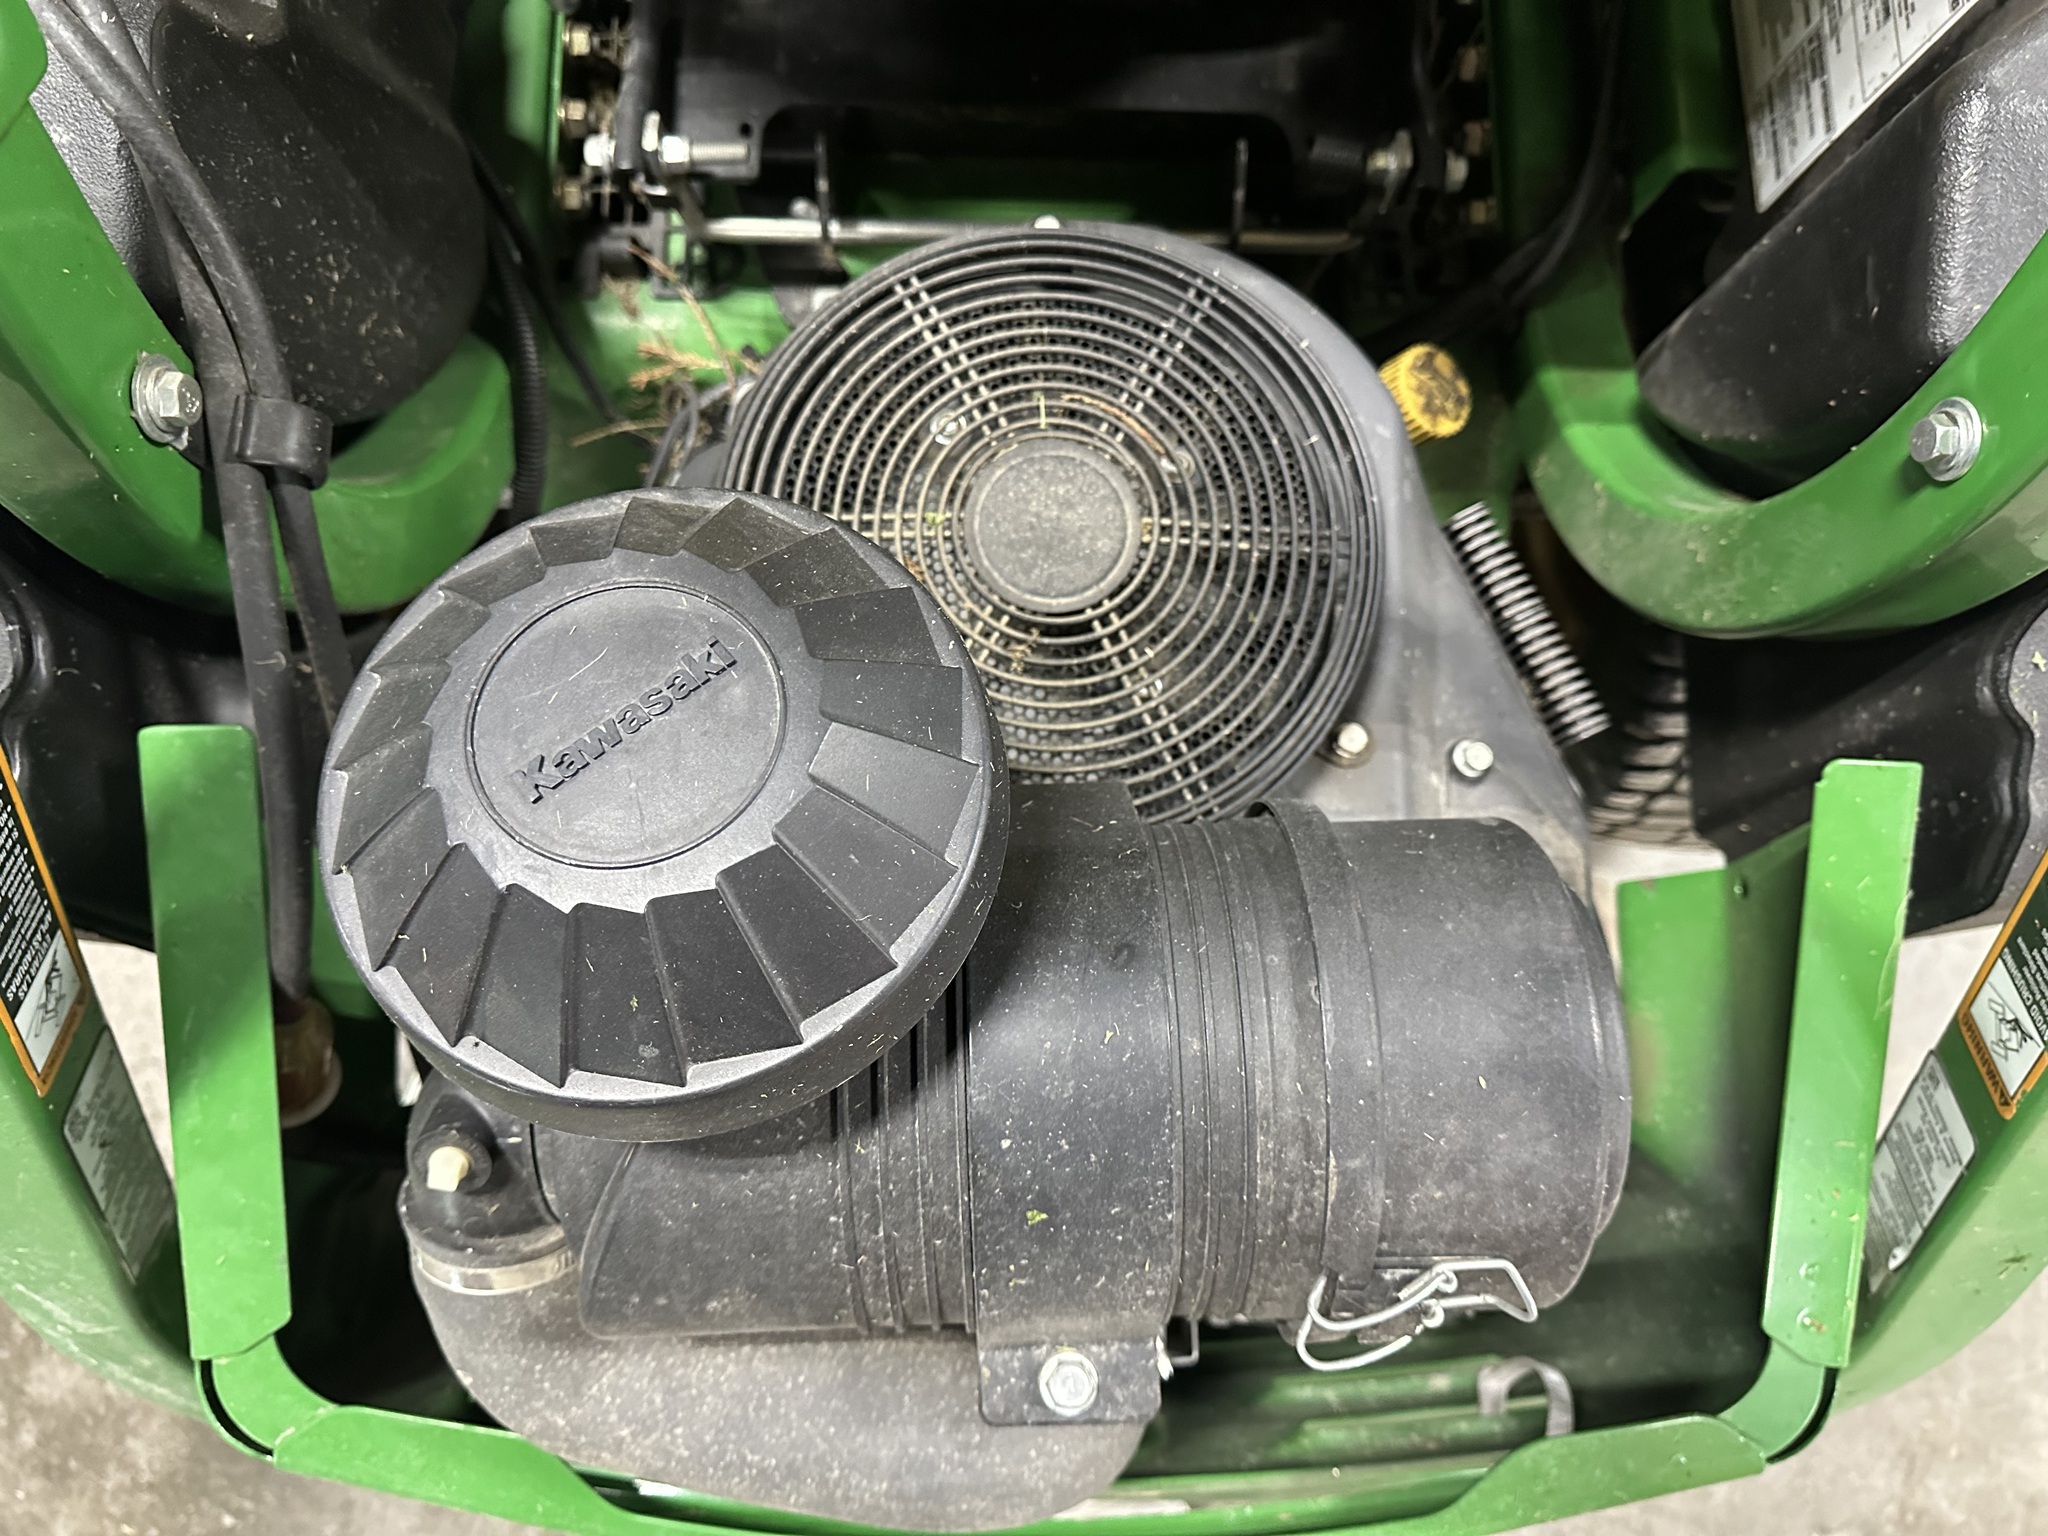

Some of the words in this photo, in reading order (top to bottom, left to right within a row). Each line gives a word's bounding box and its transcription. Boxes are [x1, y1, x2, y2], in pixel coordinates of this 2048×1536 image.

[511, 636, 738, 804] Kawasaki
[5, 907, 52, 1003] APLASTADURAS
[28, 931, 51, 977] EVITAR
[2000, 944, 2033, 1008] CRUSHING
[17, 972, 31, 1001] LAS
